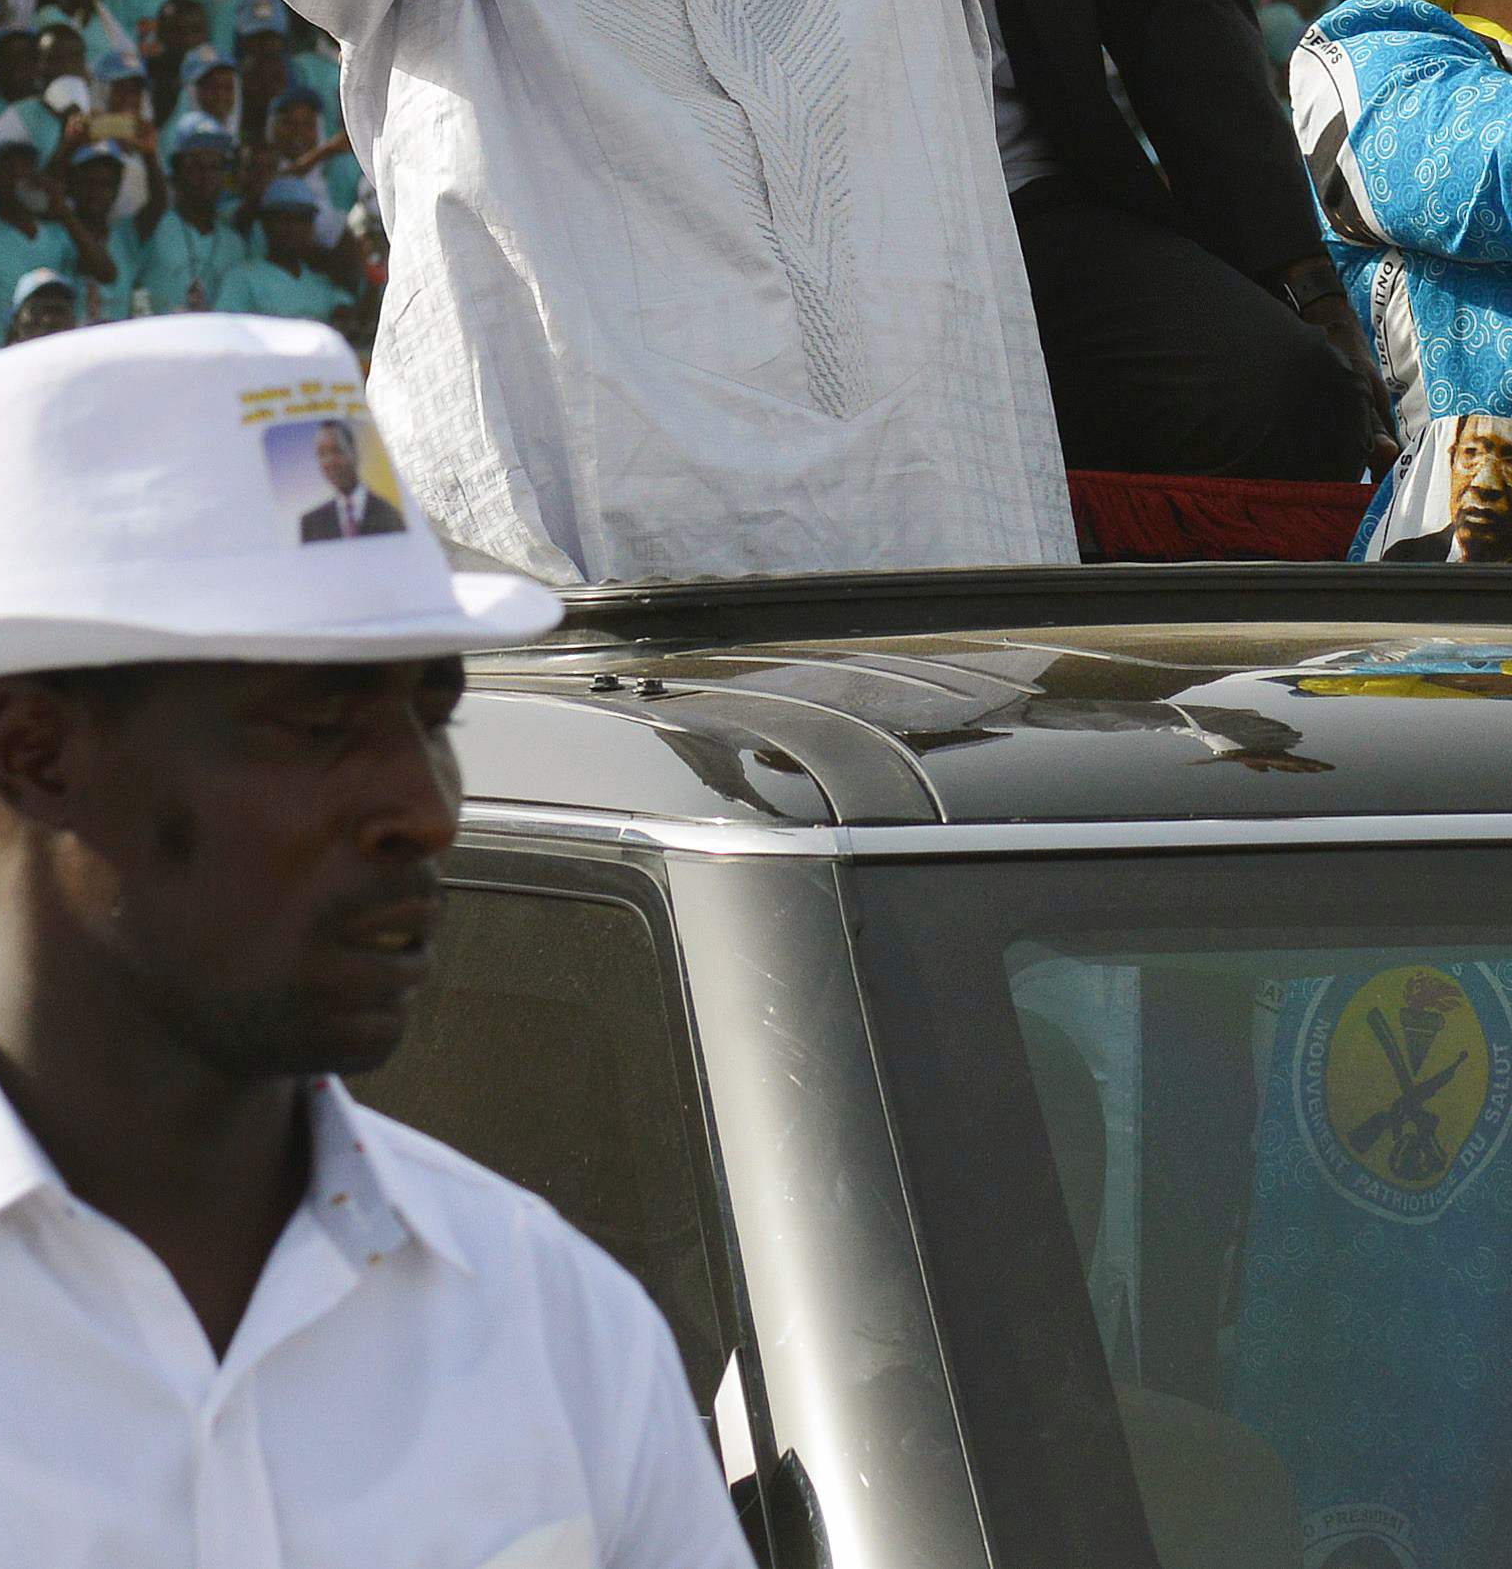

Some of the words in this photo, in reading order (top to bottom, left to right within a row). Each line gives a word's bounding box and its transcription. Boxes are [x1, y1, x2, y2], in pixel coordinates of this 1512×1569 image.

[1374, 260, 1395, 307] ITNO
[1305, 1017, 1351, 1172] MOUVEMENT
[1459, 1133, 1486, 1170] DU
[1484, 1042, 1512, 1125] SALUT
